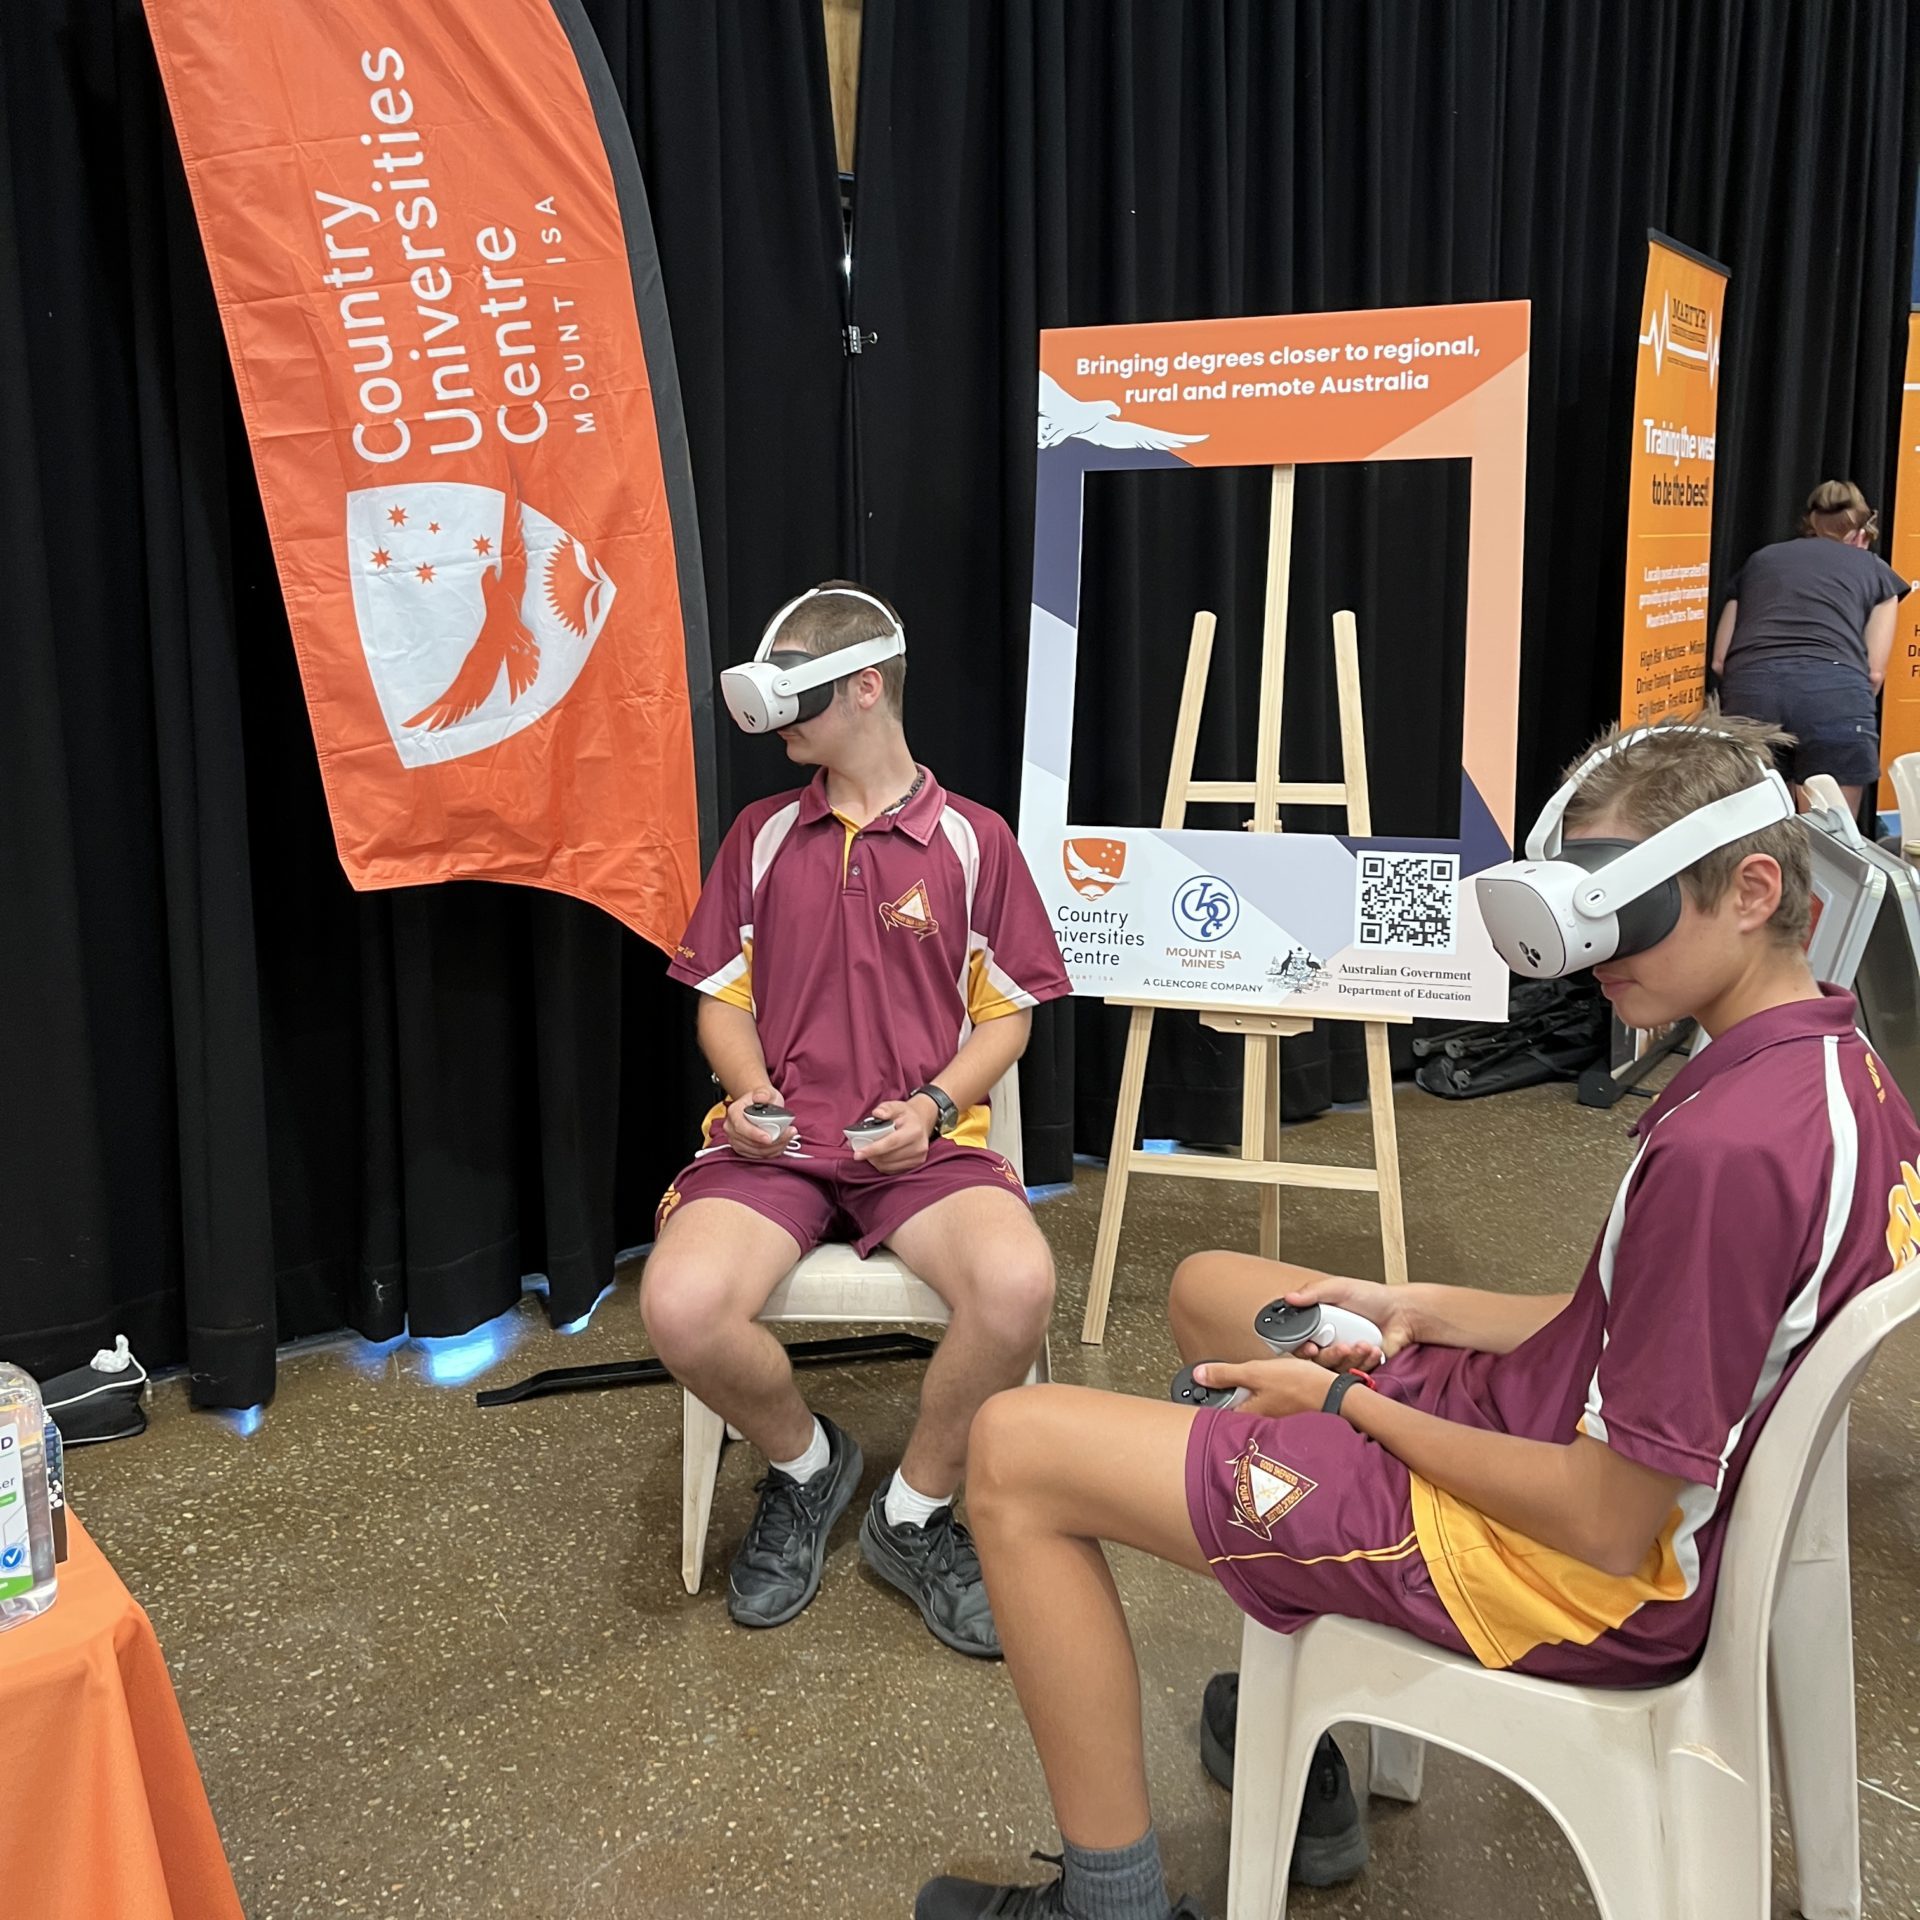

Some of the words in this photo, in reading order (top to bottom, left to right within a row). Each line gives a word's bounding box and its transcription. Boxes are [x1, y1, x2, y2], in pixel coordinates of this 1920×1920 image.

[535, 196, 566, 264] ISA
[361, 46, 482, 455] Universities
[315, 190, 411, 463] Country
[476, 226, 548, 444] Centre
[553, 296, 596, 433] MOUNT
[1076, 353, 1168, 379] Bringing
[1173, 352, 1265, 375] degrees
[1269, 346, 1340, 365] closer
[1344, 343, 1368, 361] to
[1373, 335, 1480, 364] regional,
[1125, 383, 1178, 403] rural
[1182, 381, 1227, 400] and
[1231, 378, 1315, 398] remote
[1320, 370, 1429, 394] Australia
[1643, 418, 1680, 467] Training
[1057, 906, 1129, 929] Country
[1054, 927, 1145, 946] niversities
[1061, 947, 1120, 966] Centre
[1165, 947, 1217, 959] MOUNT
[1220, 950, 1241, 960] ISA
[1181, 959, 1225, 970] MINES
[1338, 963, 1397, 977] Australian
[1400, 967, 1471, 981] Government
[1143, 978, 1151, 986] A
[1153, 979, 1208, 989] GLENCORE
[1210, 982, 1263, 993] COMPANY
[1338, 984, 1401, 998] Department
[1404, 988, 1415, 998] of
[1417, 990, 1471, 1002] Education
[1239, 1484, 1250, 1502] OUR
[1244, 1503, 1261, 1524] LIGHT
